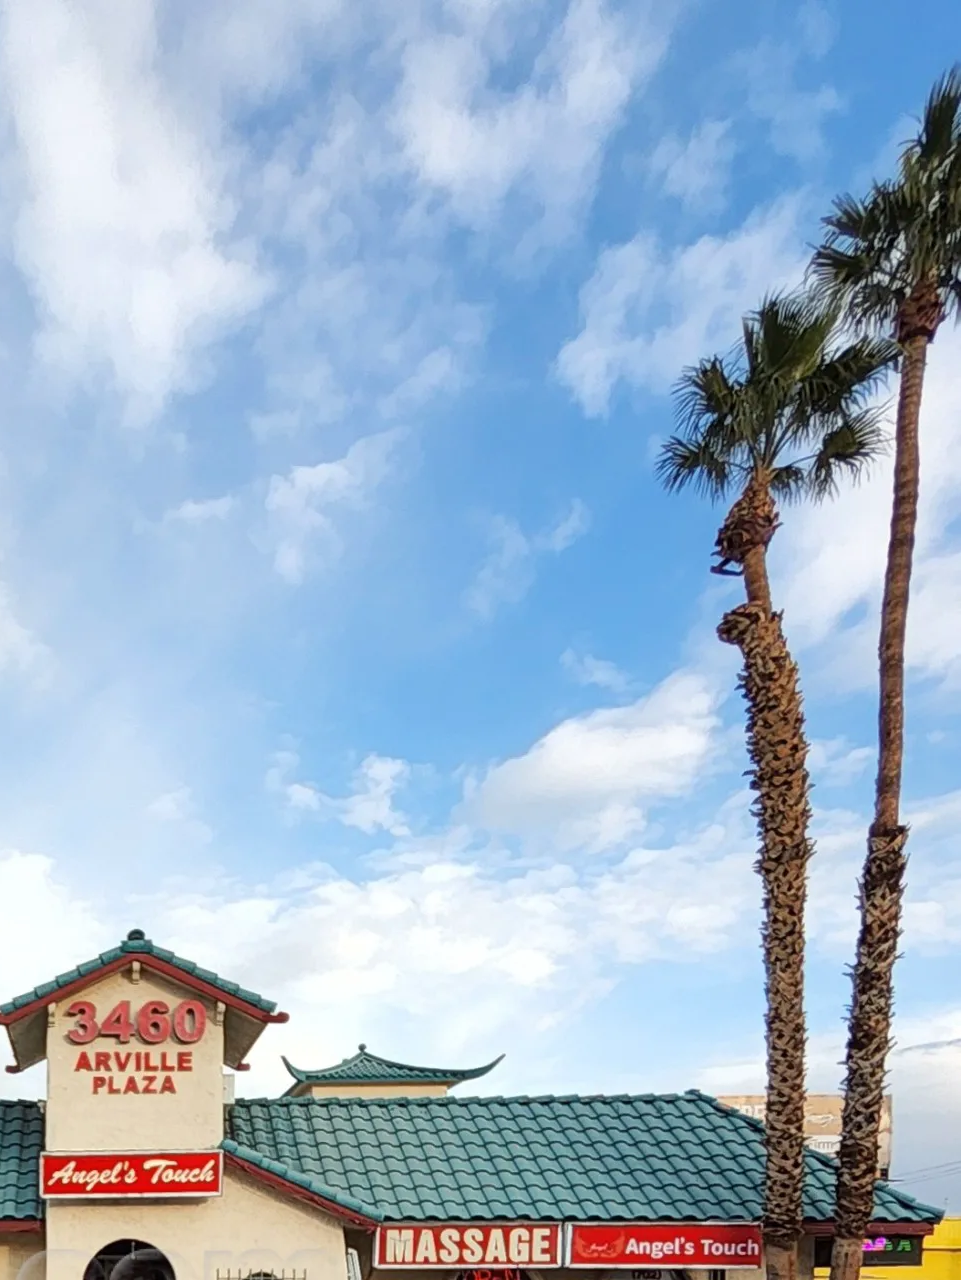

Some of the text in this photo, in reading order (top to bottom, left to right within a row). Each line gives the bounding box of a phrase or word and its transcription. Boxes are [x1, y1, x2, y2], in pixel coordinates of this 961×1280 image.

[67, 1000, 206, 1044] 3460
[74, 1051, 193, 1072] ARVILLE
[92, 1075, 177, 1095] PLAZA
[48, 1159, 216, 1191] Angel's Touch
[385, 1228, 551, 1263] MASSAGE
[625, 1237, 695, 1259] Angel's
[700, 1239, 759, 1256] Touch
